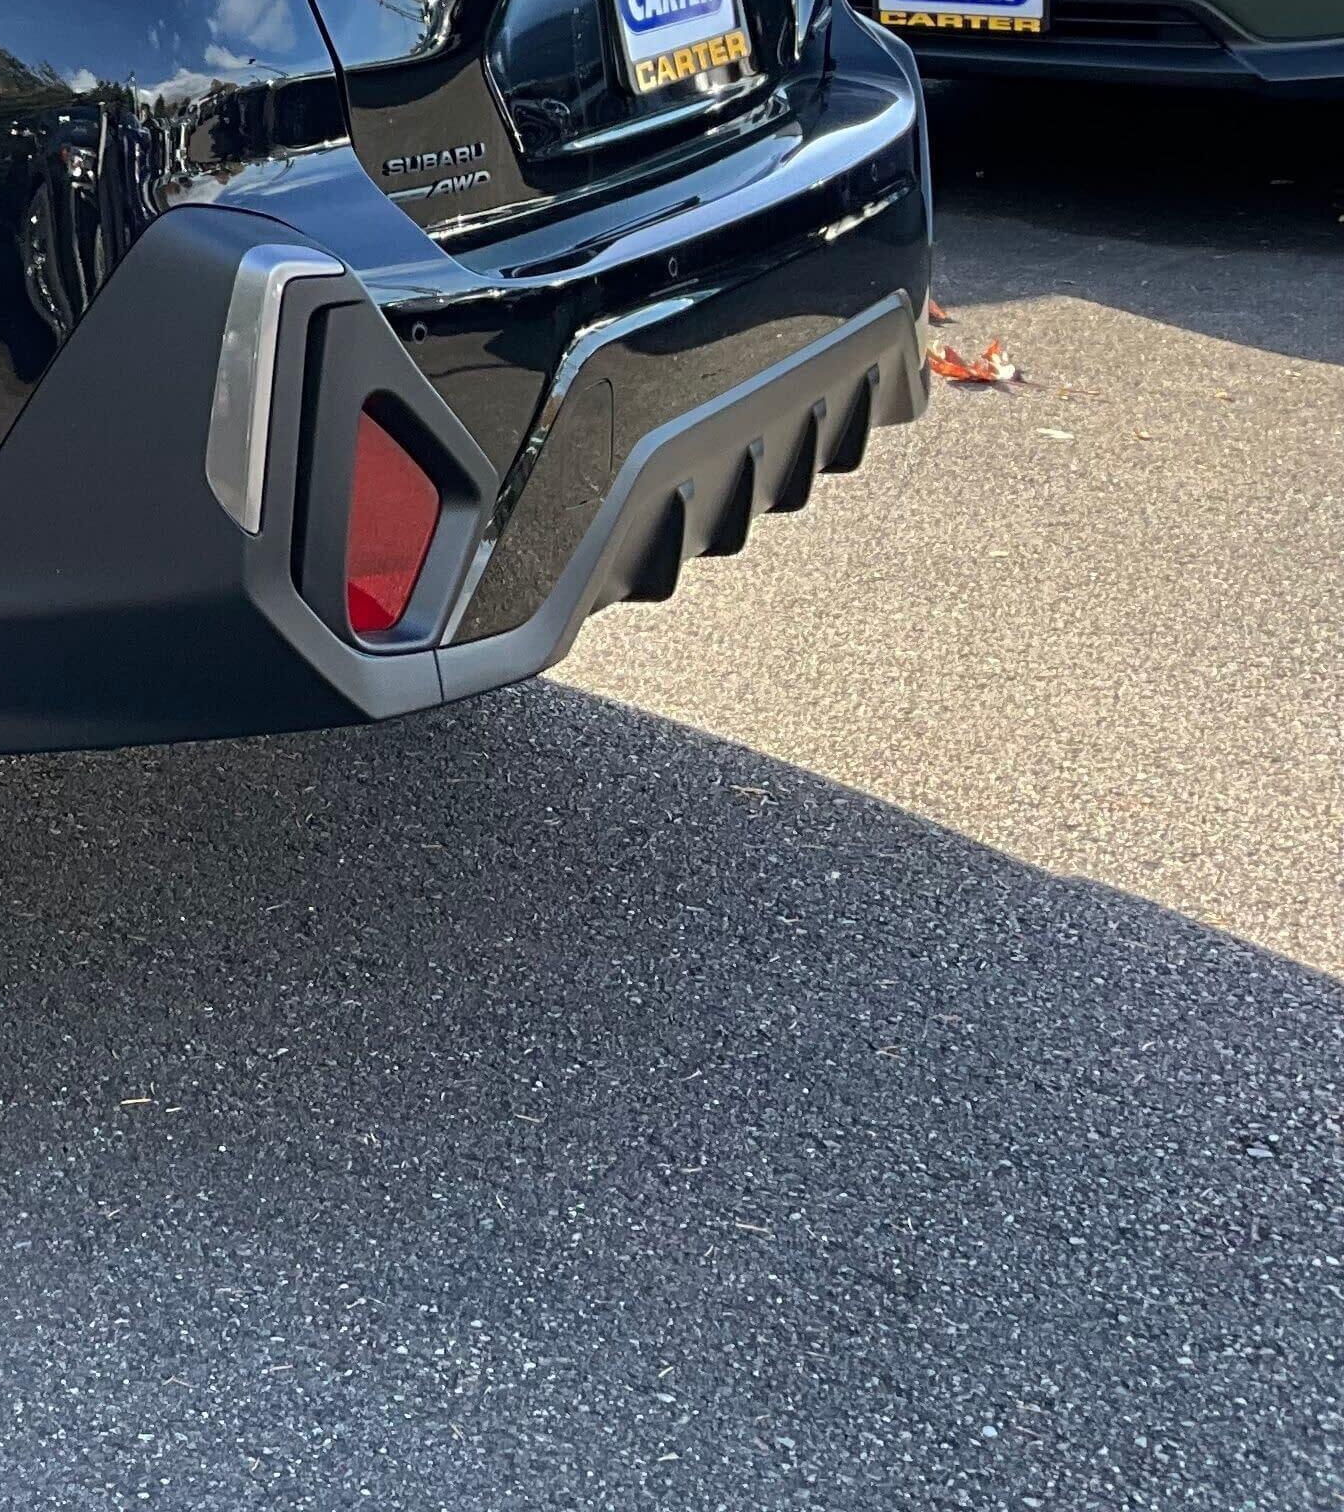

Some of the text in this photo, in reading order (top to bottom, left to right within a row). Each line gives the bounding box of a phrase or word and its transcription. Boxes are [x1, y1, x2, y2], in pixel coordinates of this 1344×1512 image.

[878, 10, 1042, 33] CARTER
[635, 32, 748, 91] CARTER
[382, 142, 487, 176] SUBARU
[429, 170, 491, 197] AWD
